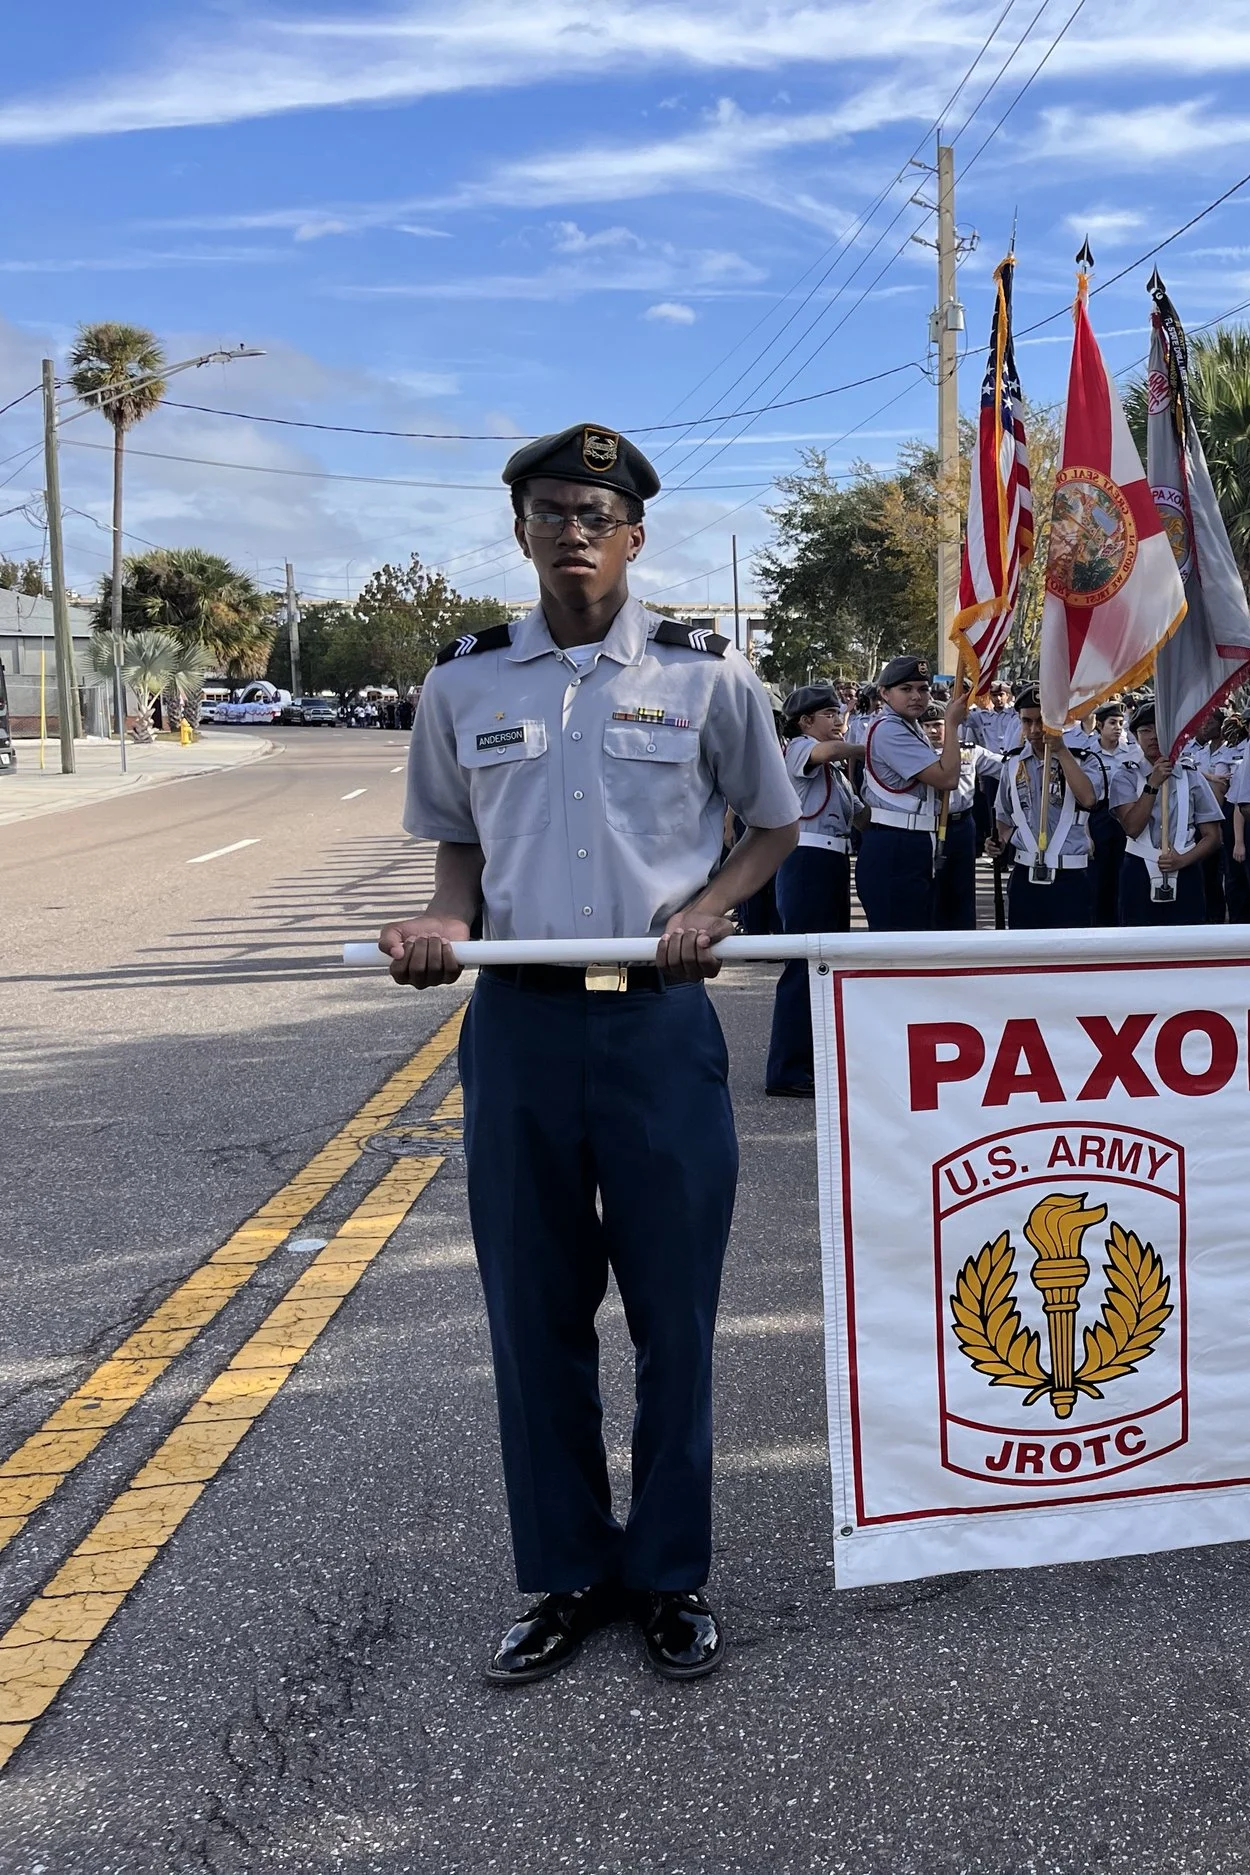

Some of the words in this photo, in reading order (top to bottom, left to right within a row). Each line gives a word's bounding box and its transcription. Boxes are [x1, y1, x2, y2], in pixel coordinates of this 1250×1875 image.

[479, 730, 523, 746] ANDERSON
[944, 1145, 1029, 1196] U.S.
[1047, 1135, 1173, 1181] ARMY
[985, 1425, 1147, 1474] JROTC
